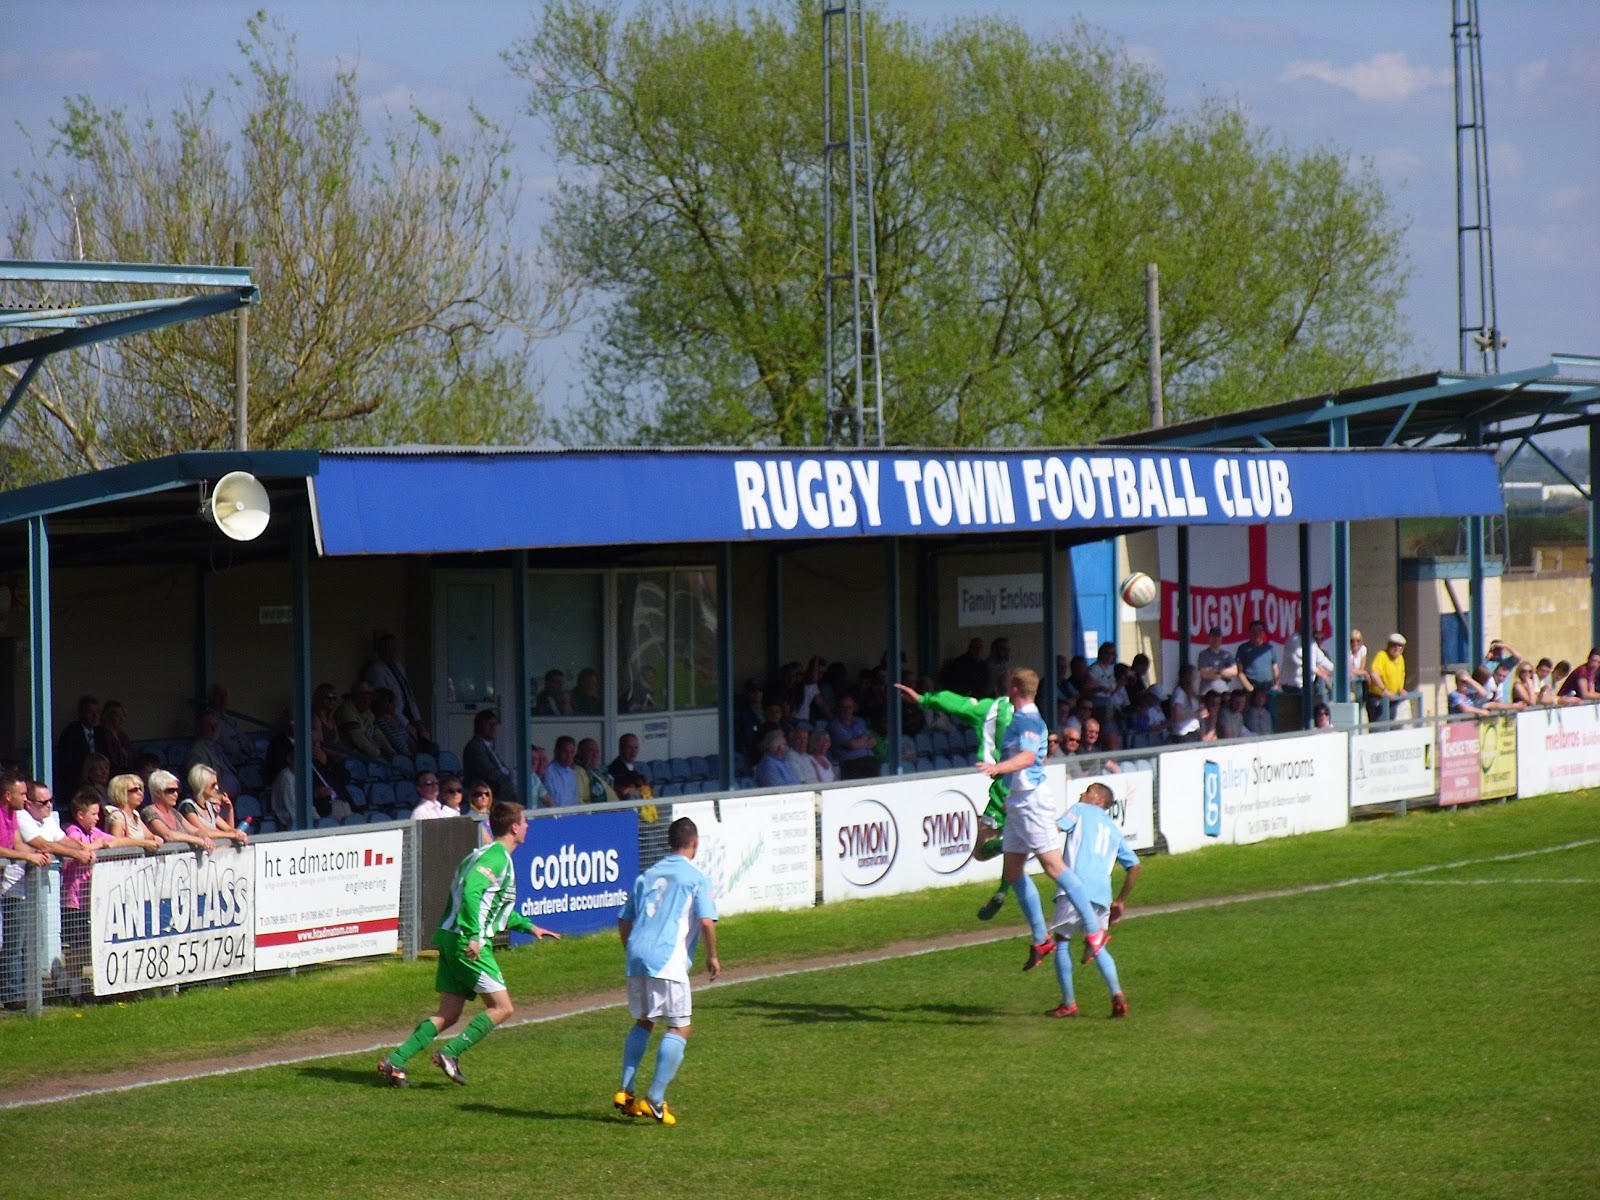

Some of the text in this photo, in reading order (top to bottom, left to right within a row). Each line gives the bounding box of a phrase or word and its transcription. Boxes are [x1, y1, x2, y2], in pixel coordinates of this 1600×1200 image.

[735, 457, 1293, 530] RUGBY TOWN FOOTBALL CLUB
[962, 586, 1043, 616] Family Enclosu
[1250, 589, 1302, 639] TOW
[1253, 757, 1315, 785] Showrooms
[838, 820, 889, 859] SYMON
[923, 810, 971, 848] SYMON
[264, 847, 359, 878] ht admatom
[530, 844, 620, 890] cottons
[104, 857, 249, 942] ANY GLASS
[345, 879, 387, 895] engineering
[521, 888, 629, 917] chartered accountants
[106, 944, 169, 985] 01788
[176, 933, 246, 976] 551794
